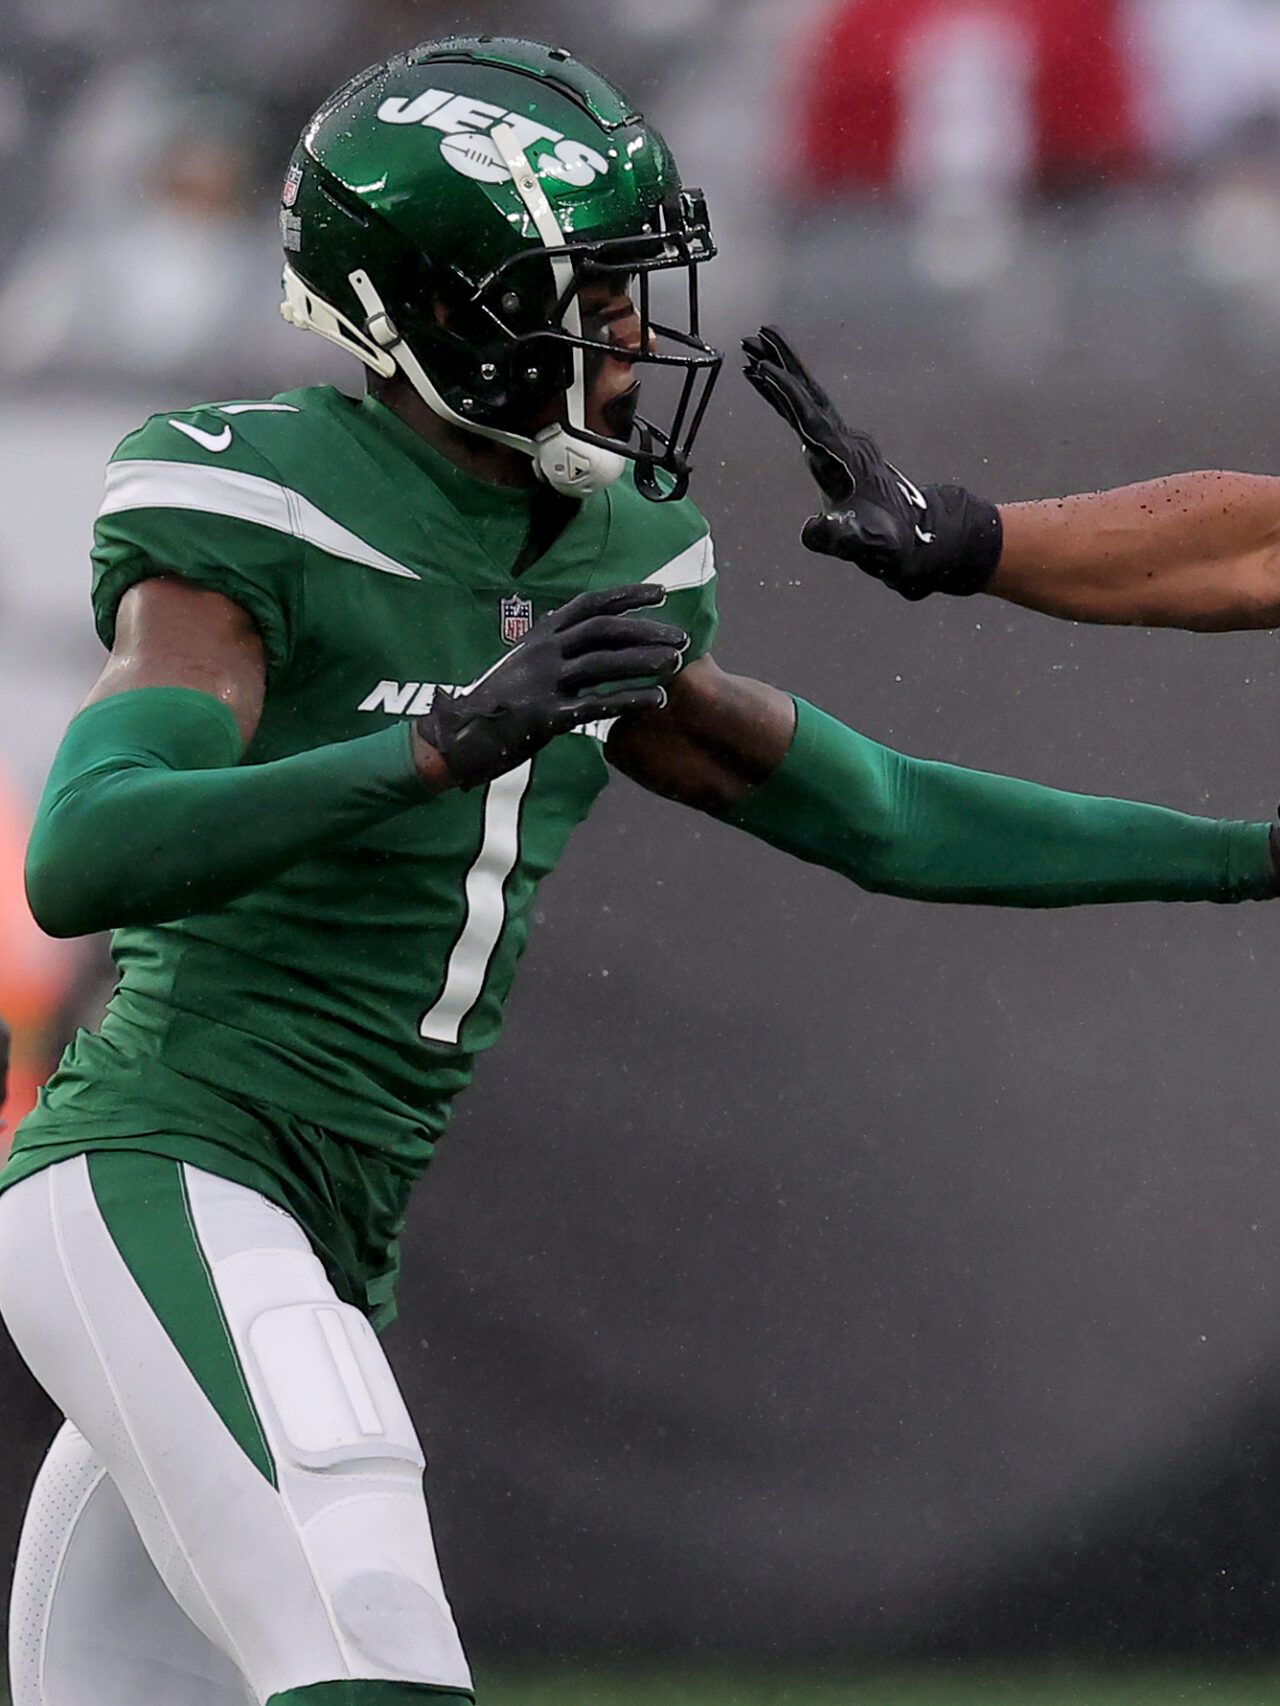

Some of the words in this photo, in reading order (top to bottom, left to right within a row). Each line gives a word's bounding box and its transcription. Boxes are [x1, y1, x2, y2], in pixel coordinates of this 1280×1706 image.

[377, 88, 609, 187] JETS
[357, 680, 467, 716] NE
[419, 757, 532, 1045] 1
